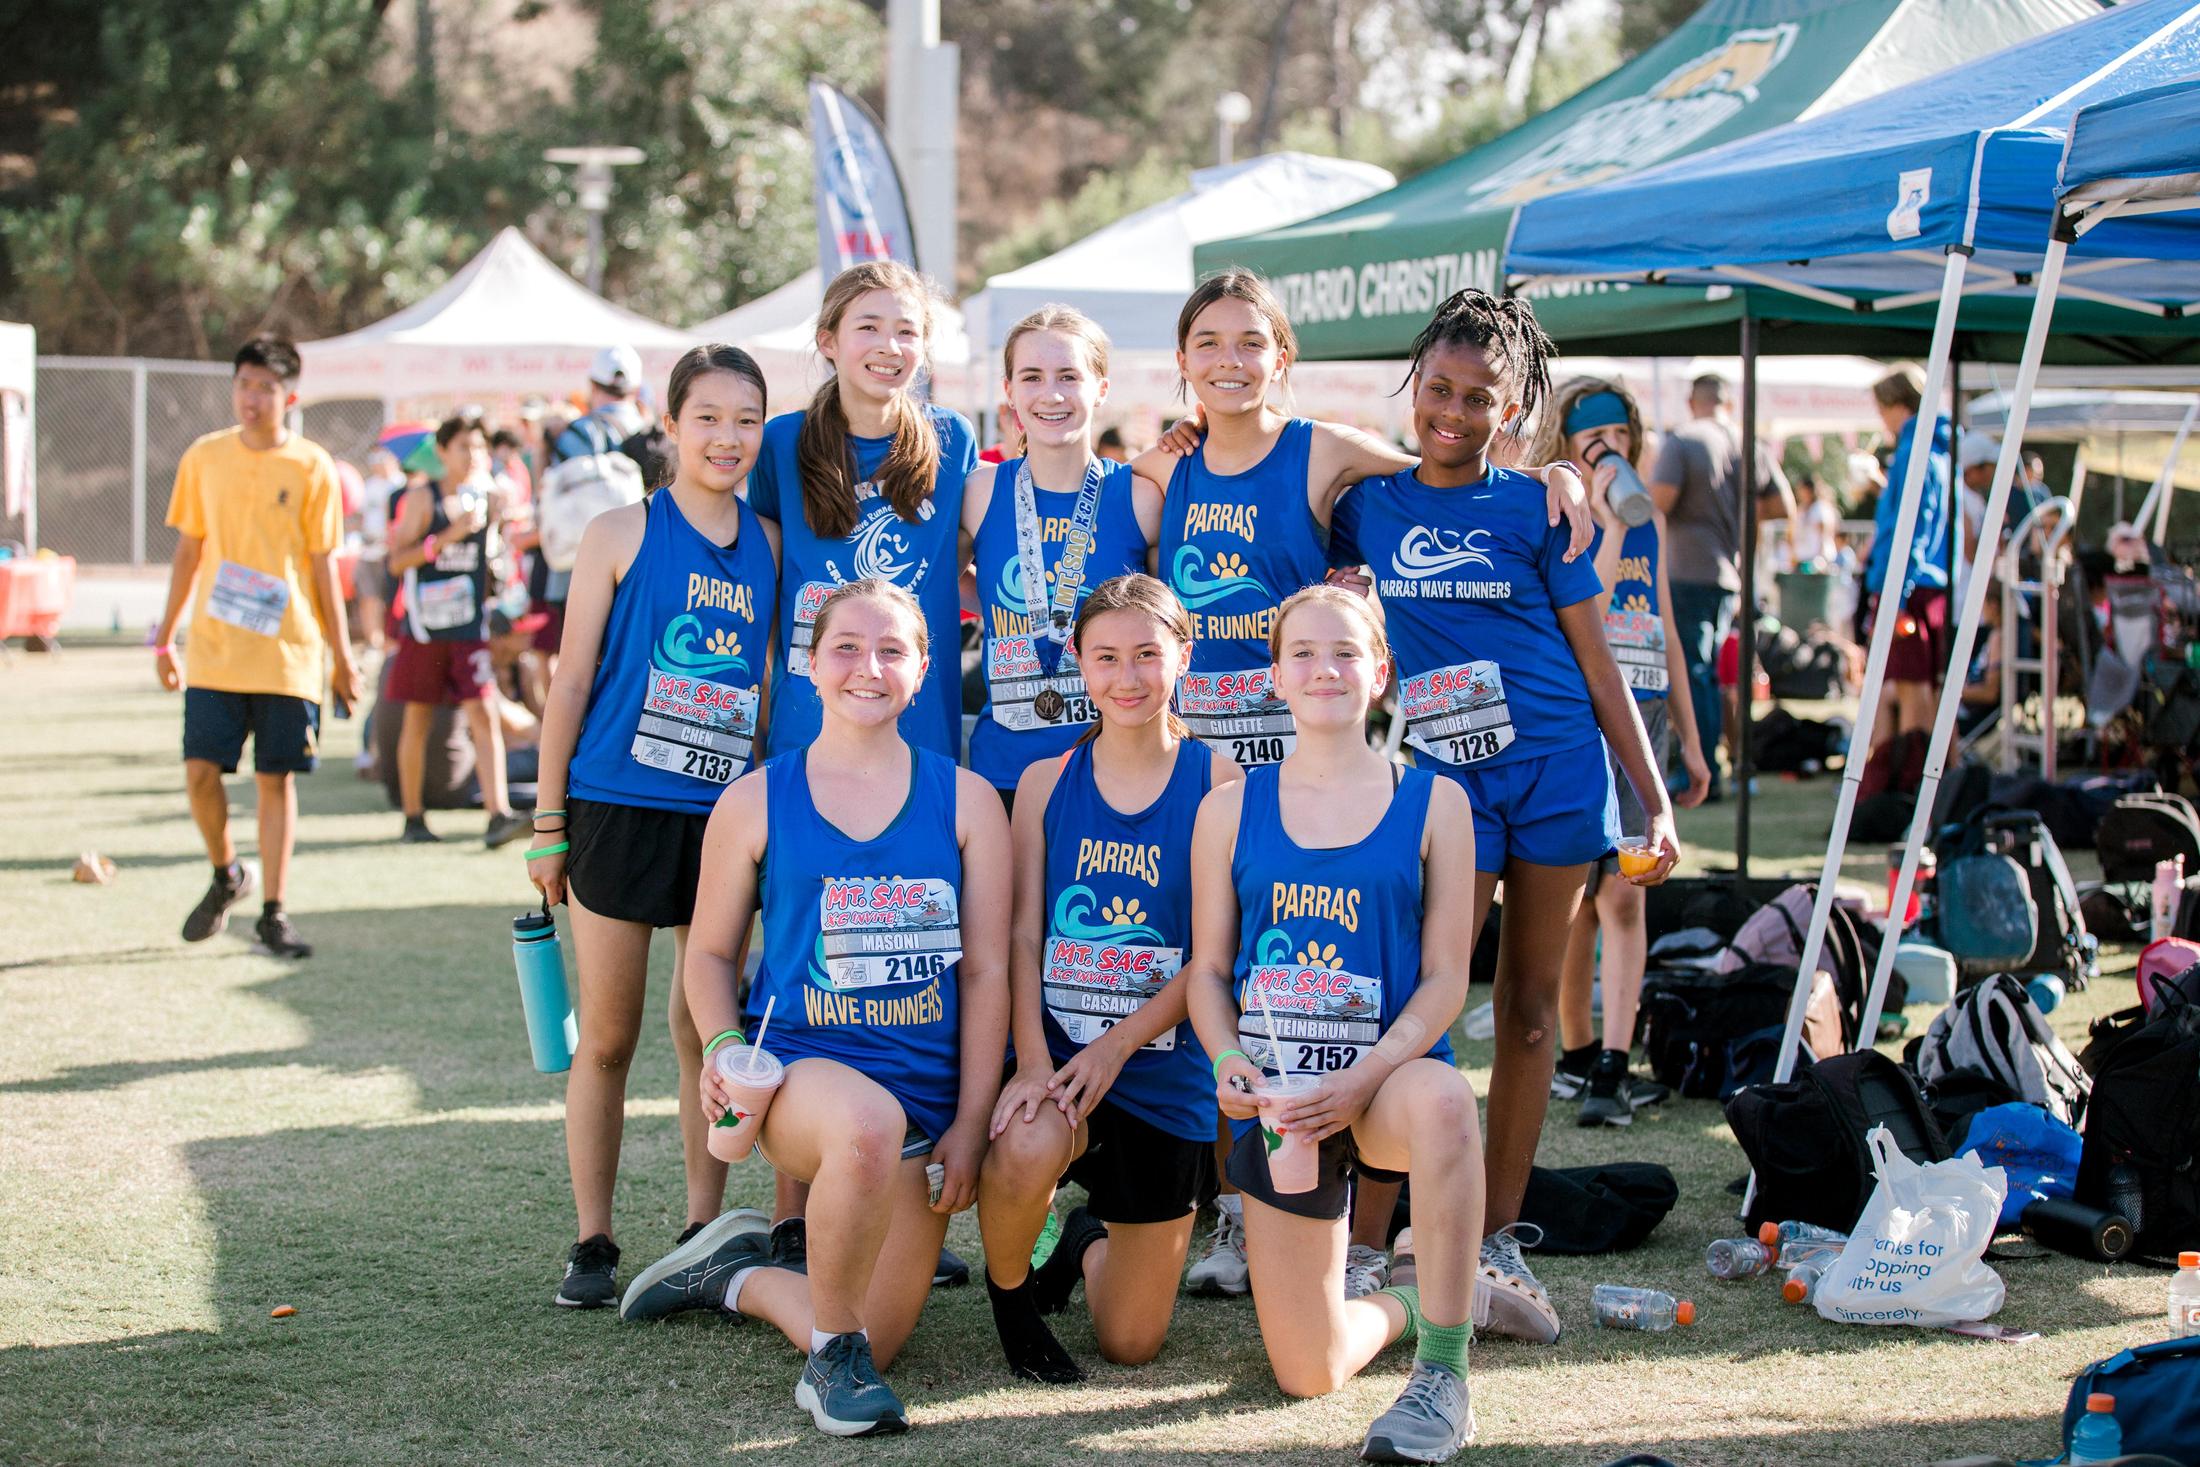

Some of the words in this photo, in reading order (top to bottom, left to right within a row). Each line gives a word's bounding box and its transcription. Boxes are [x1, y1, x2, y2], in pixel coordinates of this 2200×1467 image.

[1264, 266, 1356, 325] NTARIO
[1358, 248, 1498, 318] CHRISTIAN
[1184, 503, 1257, 543] PARRAS
[1062, 528, 1091, 571] SAC
[1616, 556, 1652, 587] RRAS
[686, 573, 754, 624] PARRAS
[1380, 579, 1418, 599] PARRAS
[1420, 580, 1453, 599] WAVE
[1455, 581, 1511, 599] RUNNERS
[991, 604, 1031, 639] WAV
[1208, 606, 1280, 640] RUNNER
[994, 639, 1030, 661] MT.
[1216, 672, 1266, 698] SAC
[1429, 665, 1473, 697] SAC
[1631, 667, 1663, 689] 2189
[656, 675, 690, 699] MT.
[693, 683, 738, 711] SAC
[1202, 700, 1239, 712] INVITE
[672, 700, 709, 721] INVITE
[1050, 698, 1099, 724] 139
[680, 725, 714, 748] CHEN
[1210, 717, 1264, 735] GILLETTE
[1431, 714, 1472, 736] BOLDER
[1232, 737, 1285, 764] 2140
[1449, 731, 1500, 764] 2128
[682, 749, 733, 783] 2133
[1075, 838, 1161, 888] PARRAS
[826, 884, 866, 910] MT.
[870, 883, 926, 909] SAC
[1273, 882, 1360, 933] PARRAS
[851, 910, 897, 925] INVITE
[862, 933, 920, 951] MASONI
[885, 954, 945, 982] 2146
[1053, 940, 1092, 967] MT.
[1096, 947, 1154, 973] SAC
[1075, 971, 1119, 986] INVITE
[1253, 968, 1289, 991] MT.
[1293, 969, 1350, 995] SAC
[804, 984, 862, 1027] WAVE
[865, 977, 943, 1026] RUNNERS
[1081, 994, 1138, 1013] CASANA
[1271, 995, 1317, 1011] INVITE
[1297, 1045, 1358, 1071] 2152
[1874, 1239, 1913, 1255] anks
[1919, 1240, 1944, 1257] for
[1866, 1258, 1932, 1280] opping
[1848, 1275, 1875, 1291] ith
[1880, 1280, 1902, 1293] us
